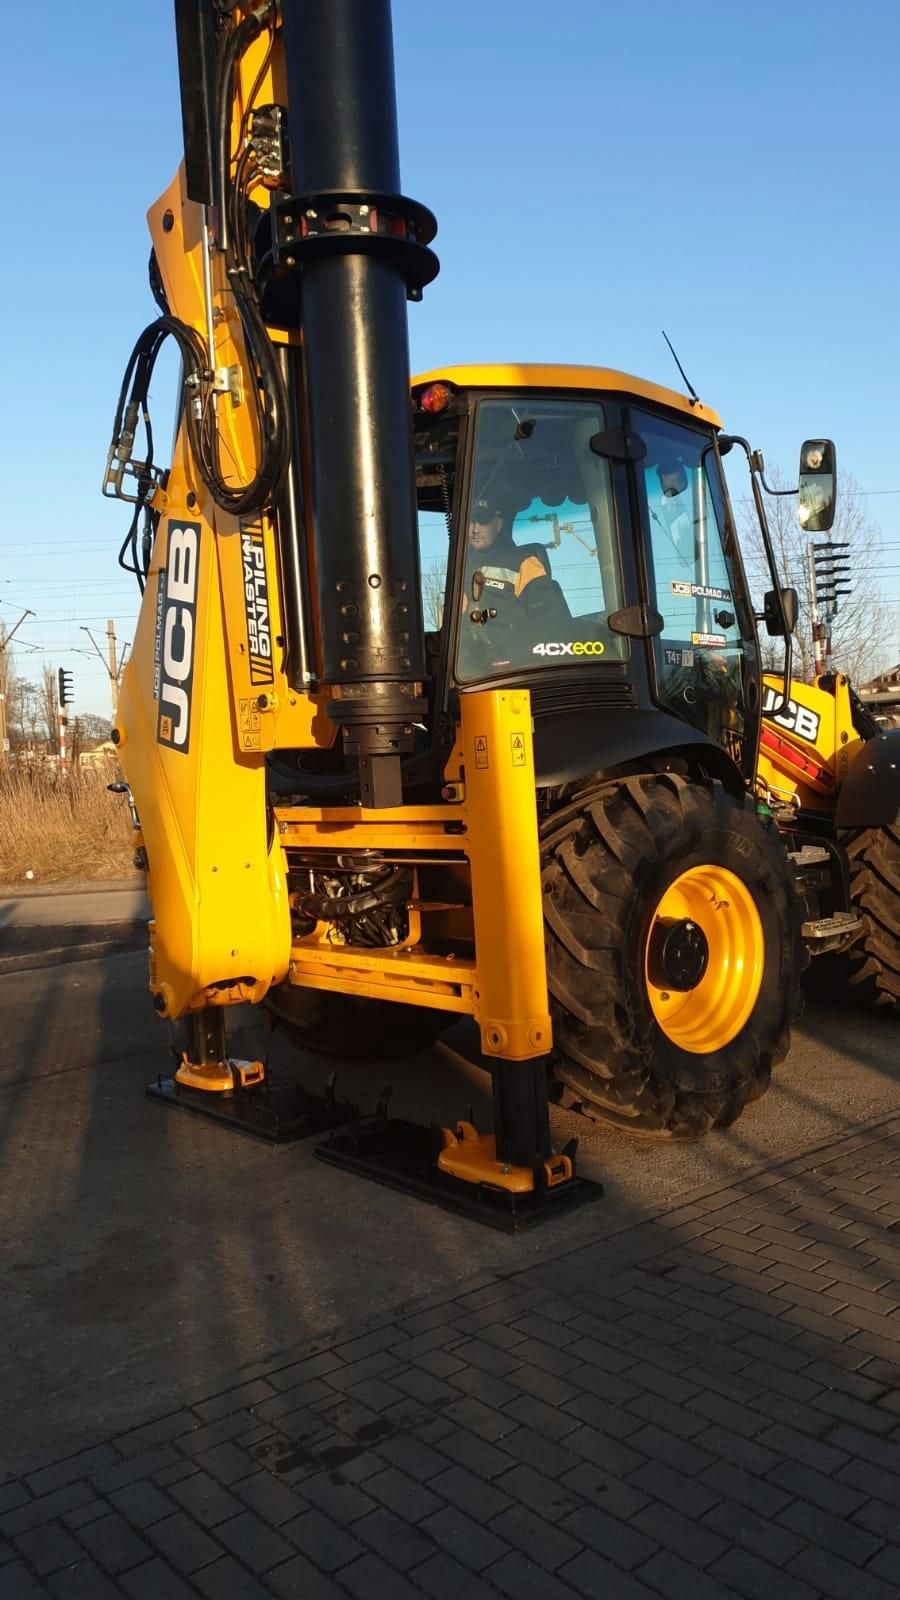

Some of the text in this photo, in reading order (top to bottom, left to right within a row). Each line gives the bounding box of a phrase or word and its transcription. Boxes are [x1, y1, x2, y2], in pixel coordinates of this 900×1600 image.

[241, 533, 259, 655] MASTER
[250, 538, 271, 657] PILING
[485, 579, 505, 590] JCB
[672, 583, 690, 594] JCB
[161, 527, 198, 745] JCB
[762, 689, 819, 741] JCB
